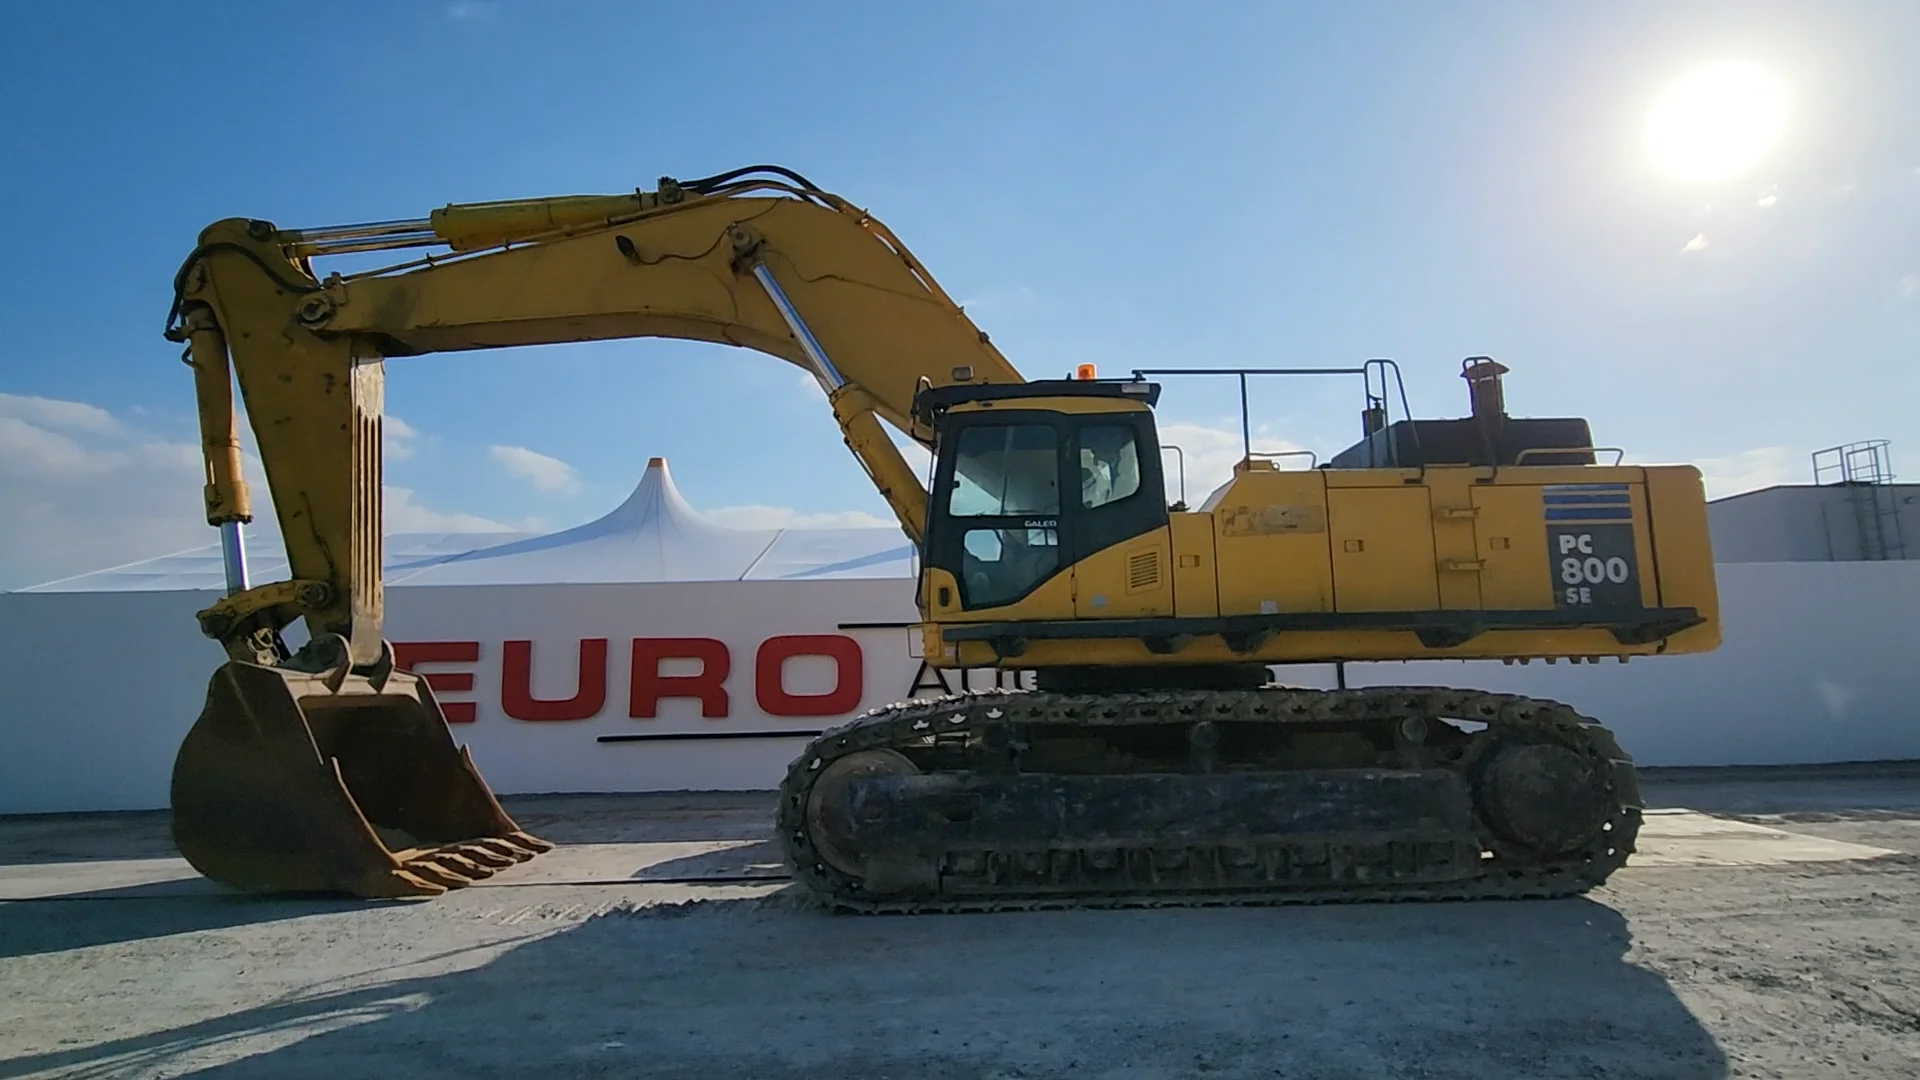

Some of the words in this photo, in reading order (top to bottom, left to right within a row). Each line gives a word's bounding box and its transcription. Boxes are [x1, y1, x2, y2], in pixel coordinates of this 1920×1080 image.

[1559, 534, 1593, 554] PC
[1561, 557, 1629, 584] 800
[1566, 587, 1592, 604] SE
[391, 634, 864, 722] EURO
